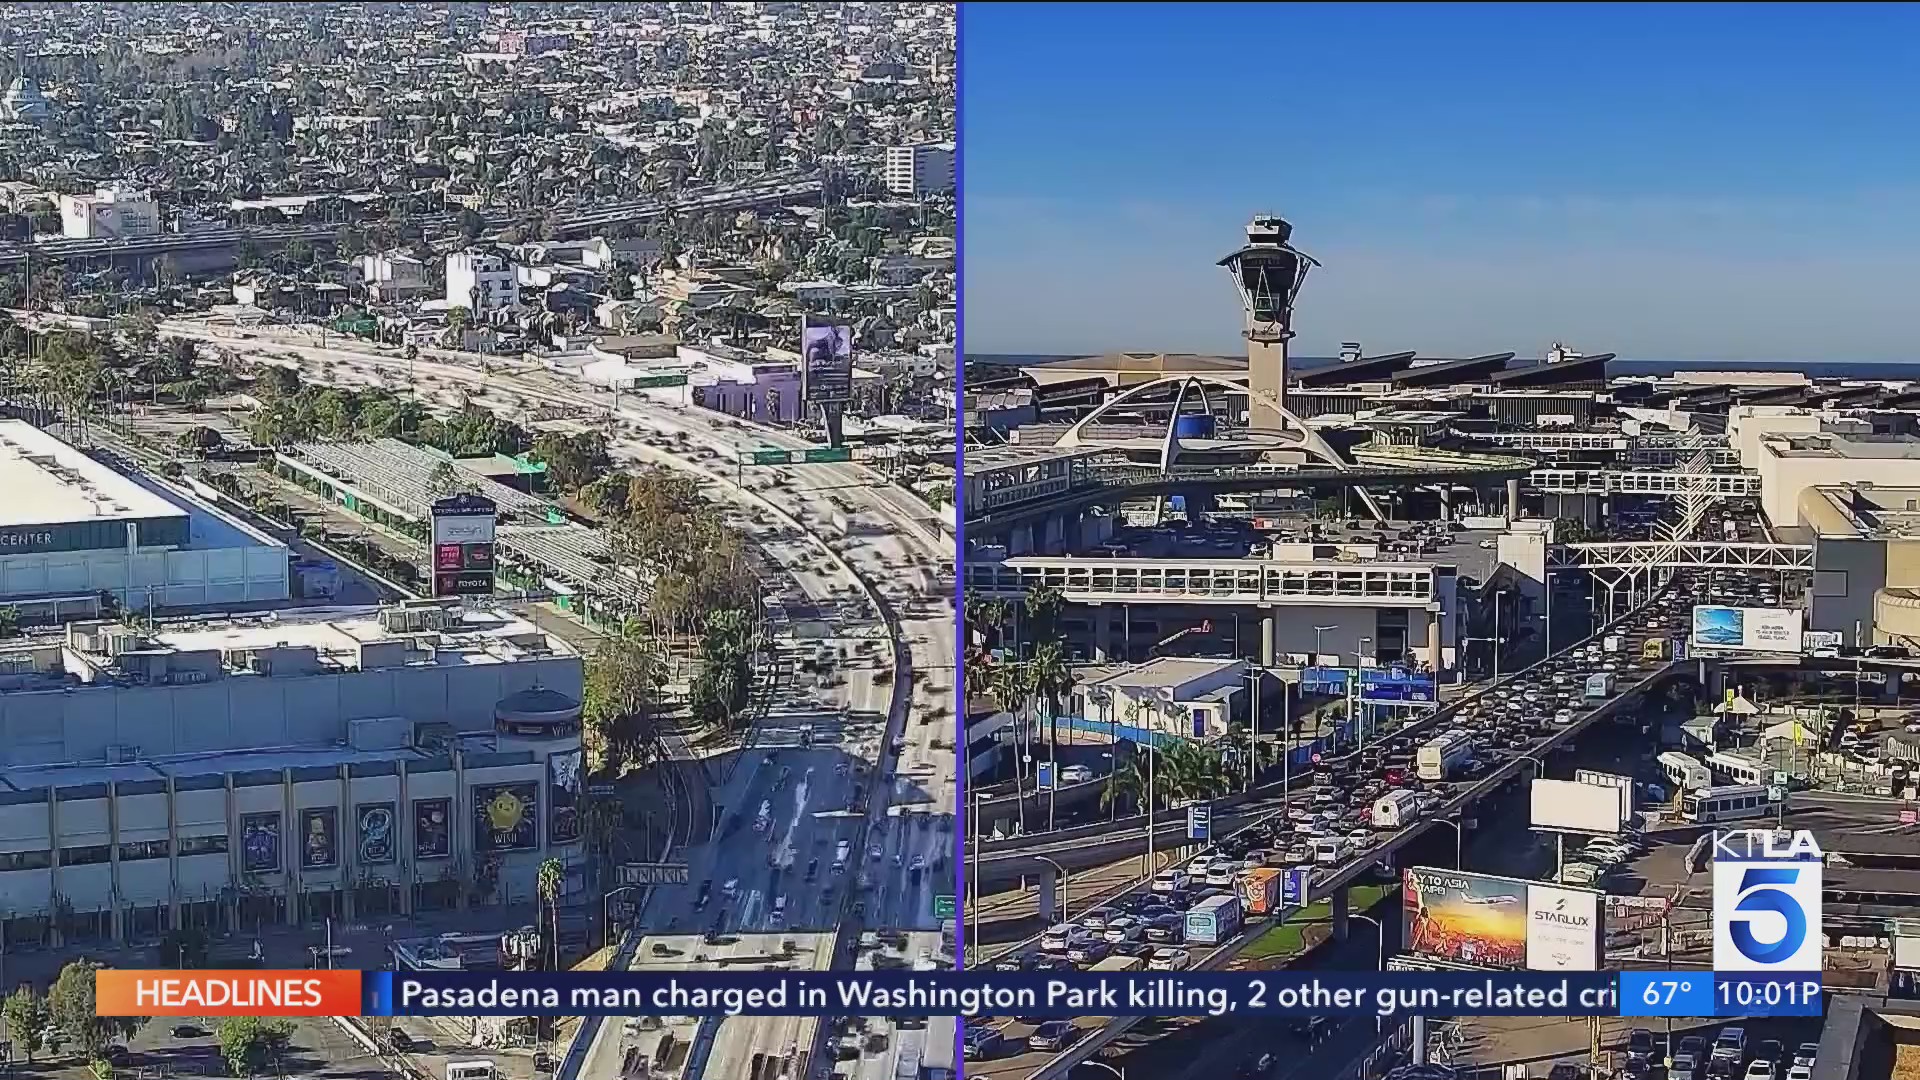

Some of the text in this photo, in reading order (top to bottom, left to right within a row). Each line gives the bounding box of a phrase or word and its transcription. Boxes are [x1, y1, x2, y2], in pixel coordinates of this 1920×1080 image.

[0, 532, 52, 546] CENTER
[494, 832, 518, 843] WISH
[1428, 876, 1442, 886] TO
[1444, 879, 1470, 890] ASIA
[1535, 910, 1589, 926] STARLUX
